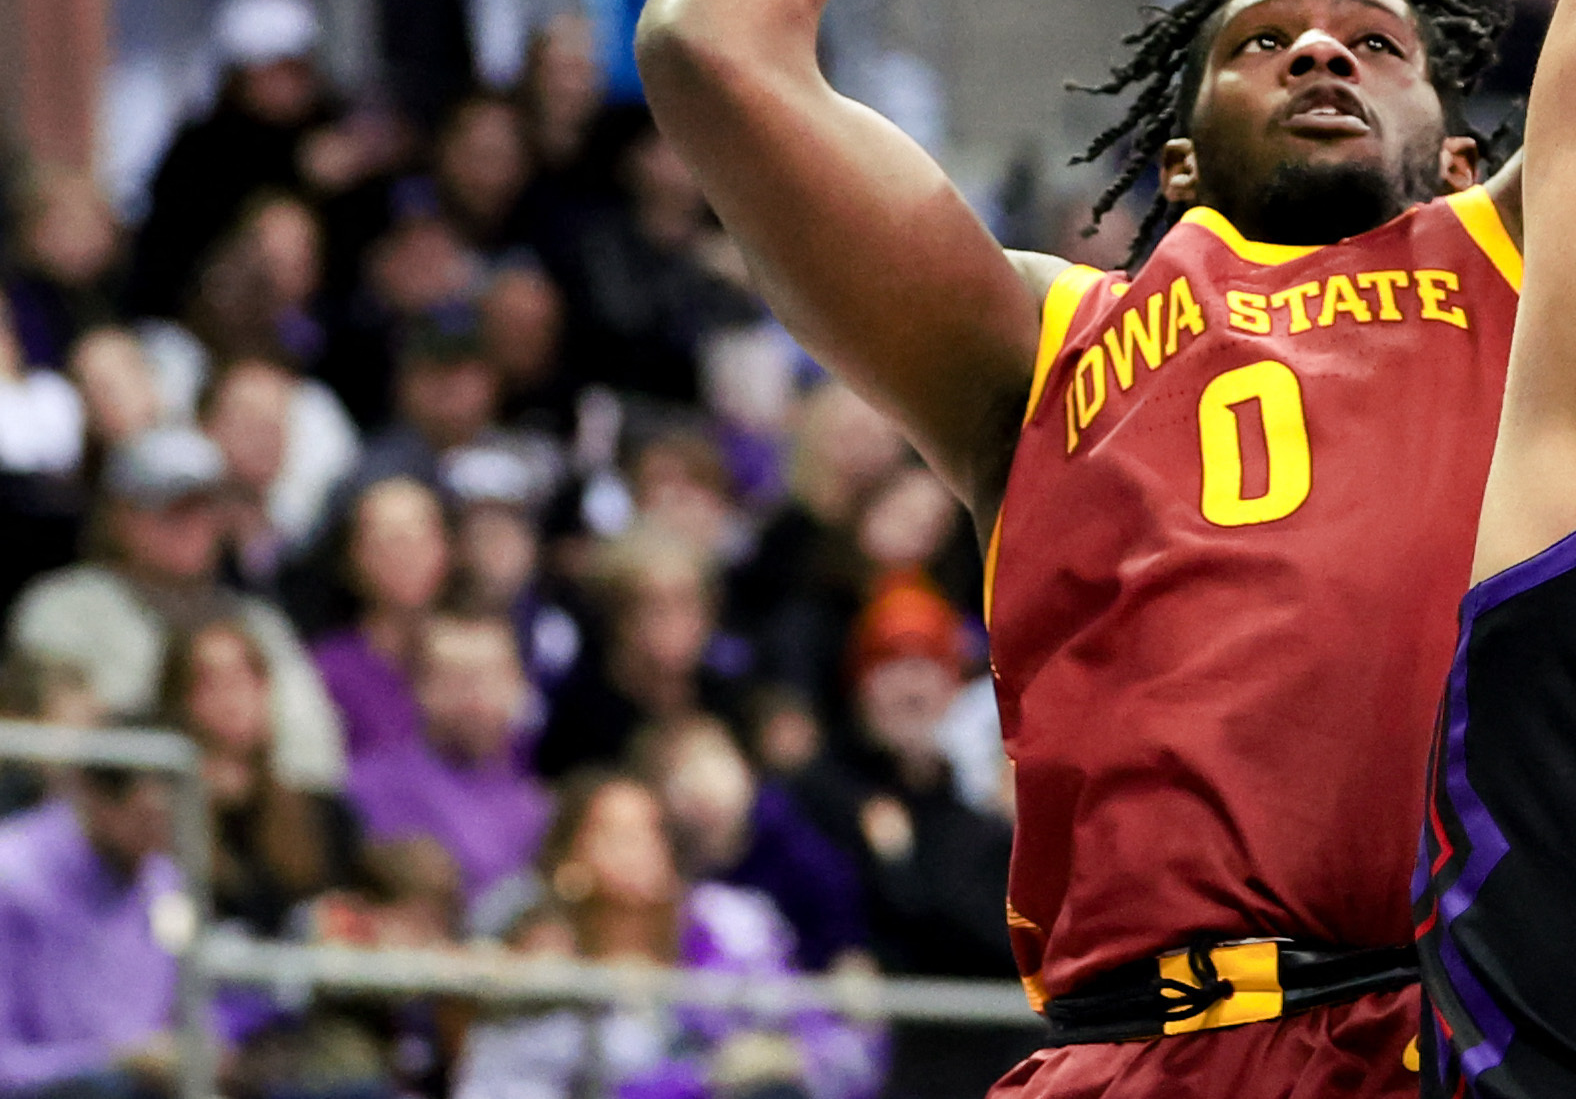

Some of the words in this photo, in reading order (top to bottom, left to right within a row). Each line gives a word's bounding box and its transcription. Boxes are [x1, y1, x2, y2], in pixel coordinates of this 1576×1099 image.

[1064, 275, 1207, 456] IOWA
[1226, 269, 1469, 336] STATE
[1198, 360, 1312, 527] 0
